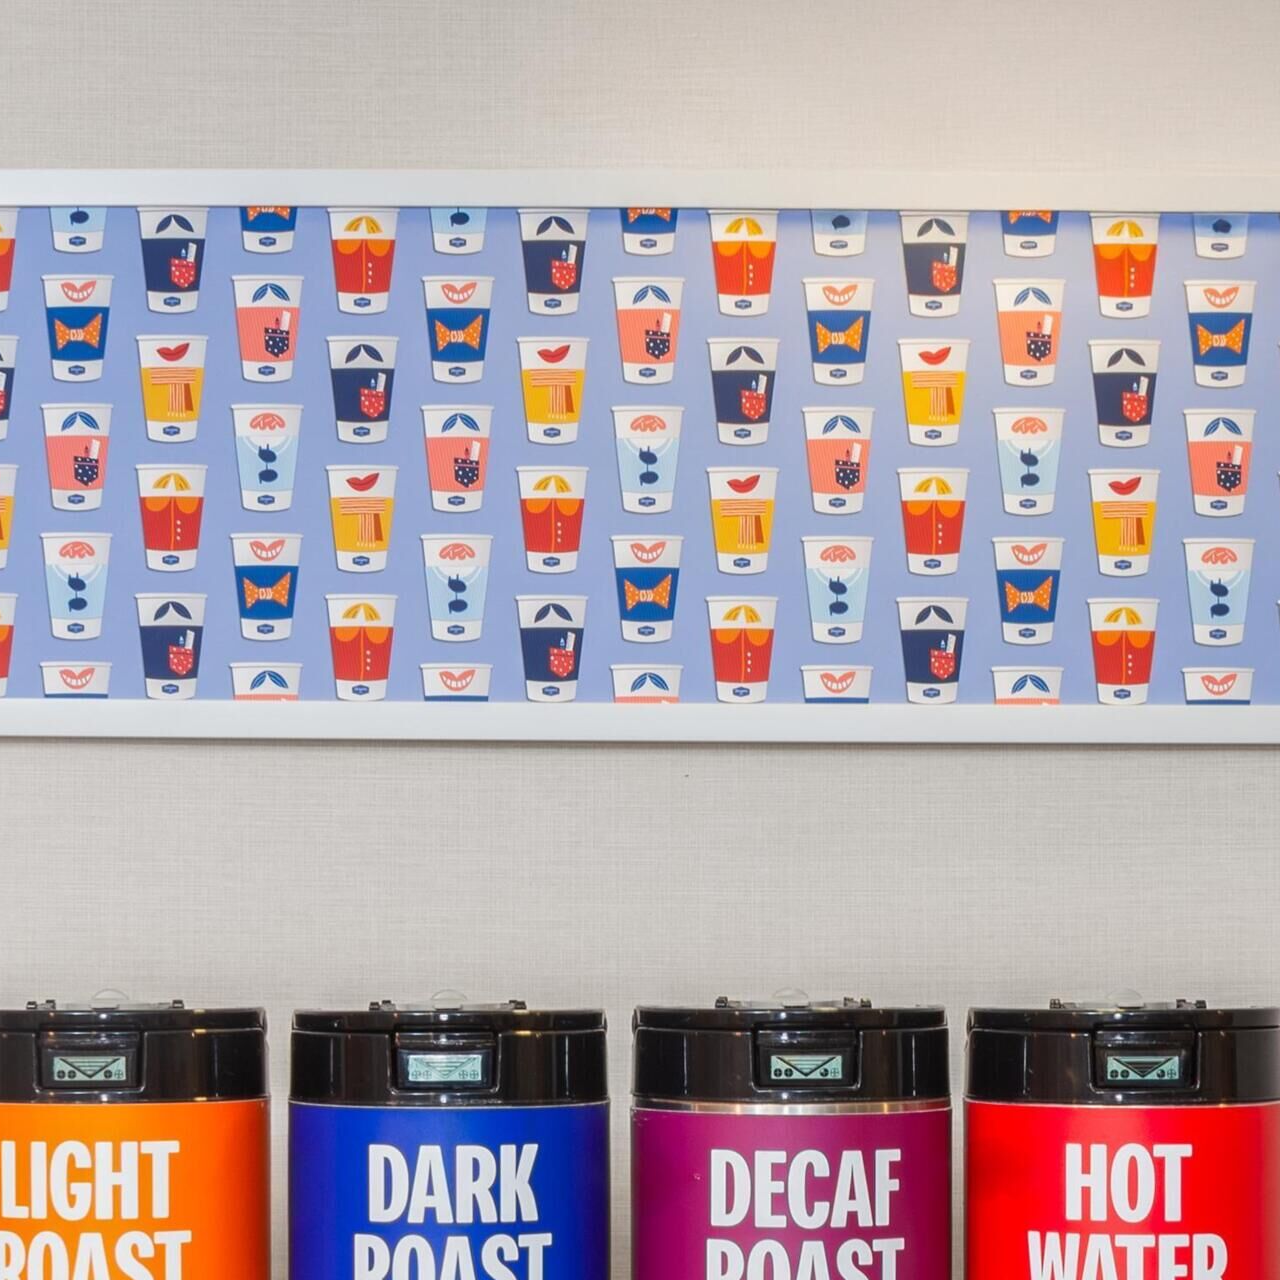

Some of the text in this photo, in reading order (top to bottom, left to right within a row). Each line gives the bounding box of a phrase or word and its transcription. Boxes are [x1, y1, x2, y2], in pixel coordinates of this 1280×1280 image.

[1, 1140, 180, 1221] LIGHT
[368, 1143, 539, 1224] DARK
[710, 1148, 901, 1230] DECAF
[1065, 1142, 1193, 1224] HOT
